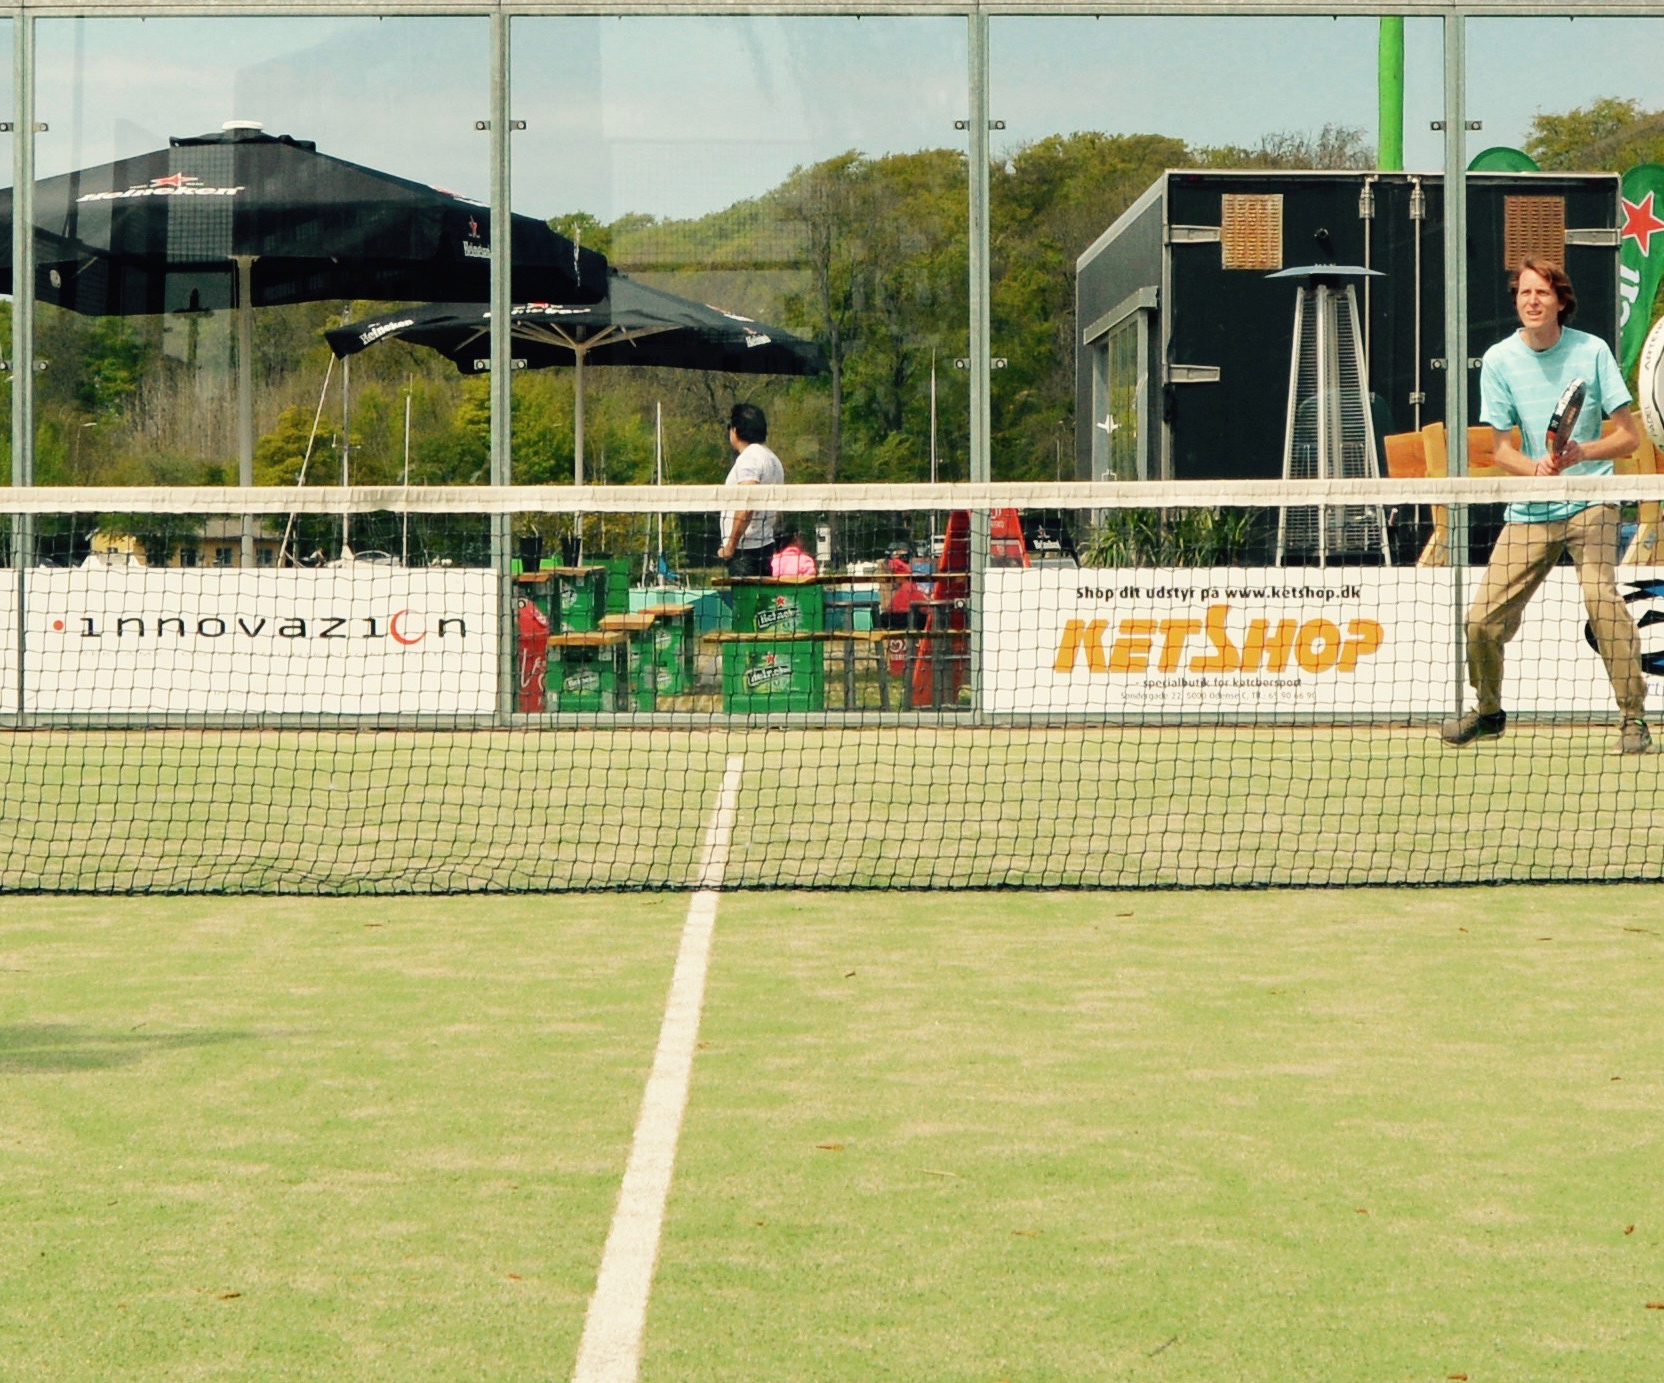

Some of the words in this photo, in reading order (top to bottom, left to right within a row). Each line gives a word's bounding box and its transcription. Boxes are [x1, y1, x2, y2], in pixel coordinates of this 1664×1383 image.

[1119, 586, 1141, 599] dit
[1146, 586, 1195, 602] udstyr
[1225, 586, 1361, 602] www.ketshop.dk
